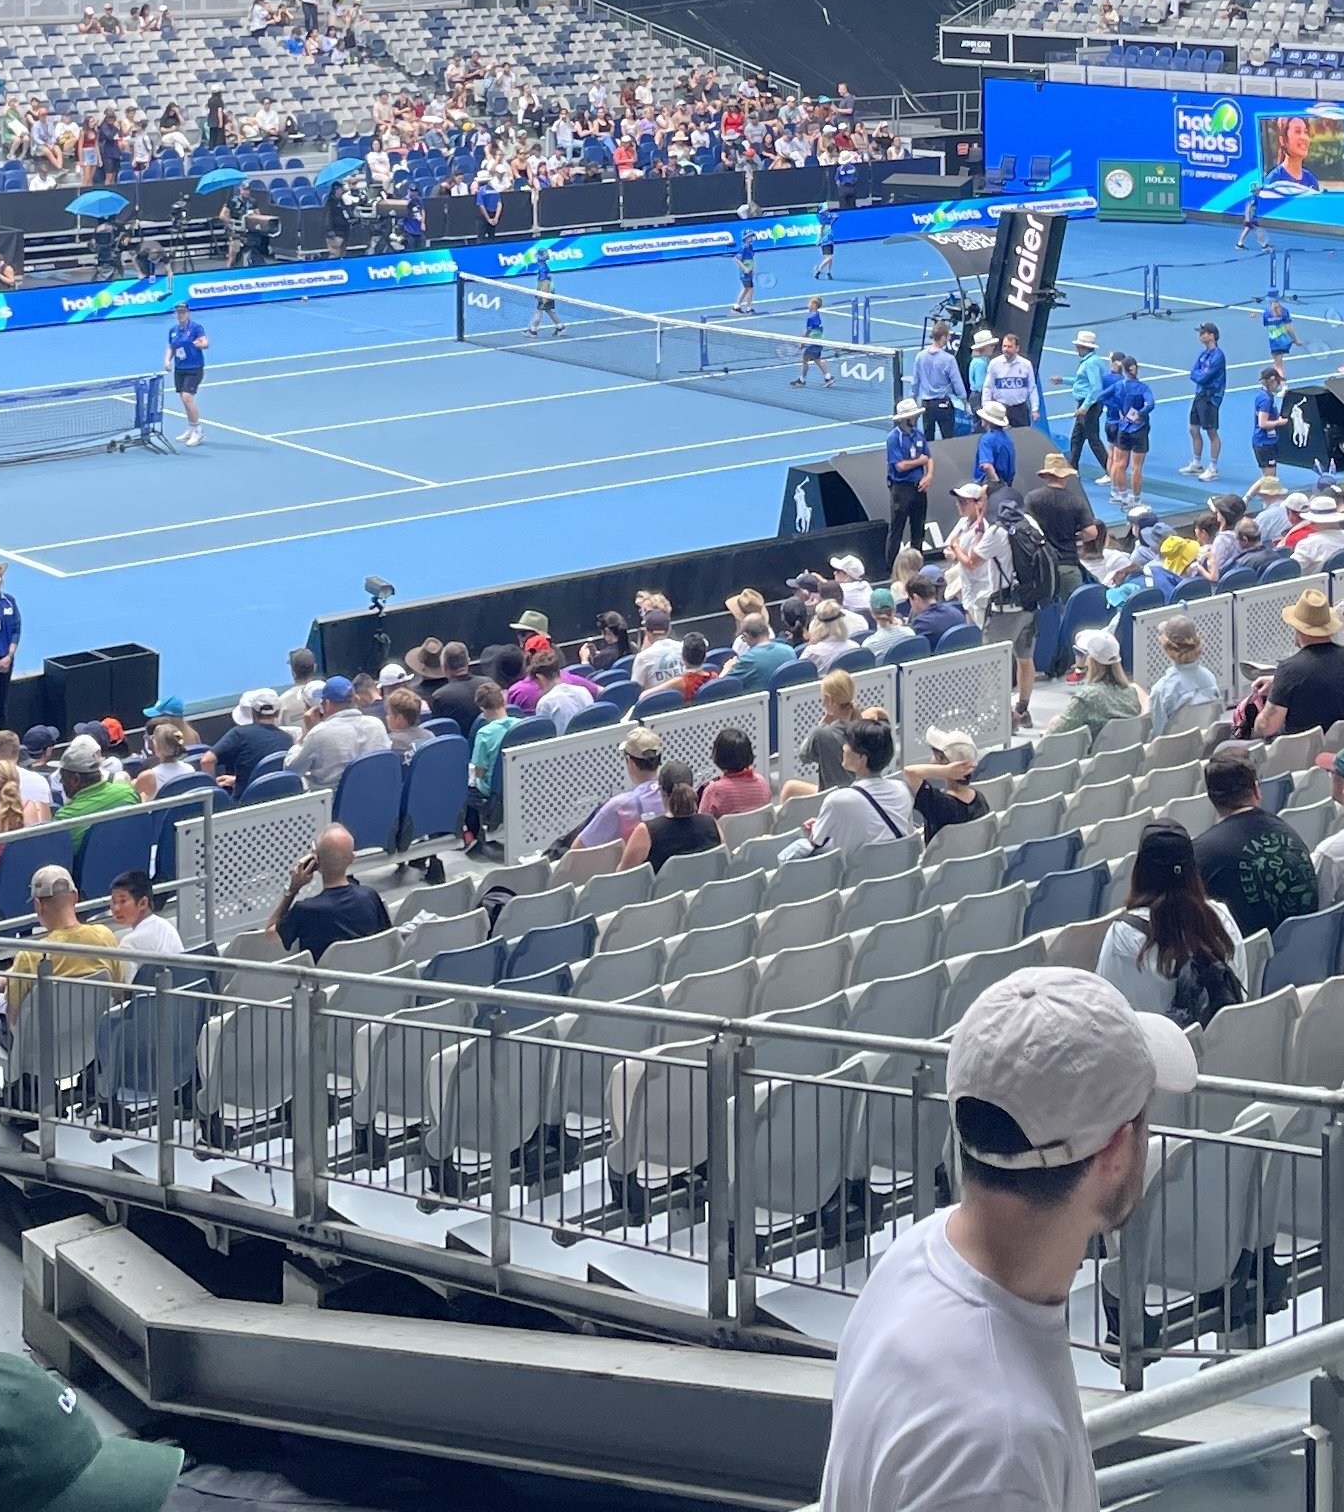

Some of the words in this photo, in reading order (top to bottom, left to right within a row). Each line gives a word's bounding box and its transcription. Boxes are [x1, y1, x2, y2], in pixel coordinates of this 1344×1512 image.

[1178, 110, 1213, 131] hot
[1178, 131, 1238, 152] shots
[1191, 150, 1226, 163] tennis
[1144, 175, 1176, 185] ROLEX
[911, 212, 935, 225] hot
[946, 208, 982, 223] shots
[605, 235, 730, 253] hotshots.tennis.com.au
[498, 252, 525, 267] hot
[548, 248, 585, 261] hots
[1007, 214, 1044, 312] Haier
[367, 264, 397, 280] hot
[411, 259, 458, 276] shots
[193, 273, 344, 295] hotshots.tennis.com.au
[62, 295, 94, 311] hot
[1242, 832, 1294, 855] TASSIE
[1239, 861, 1260, 904] KEEP
